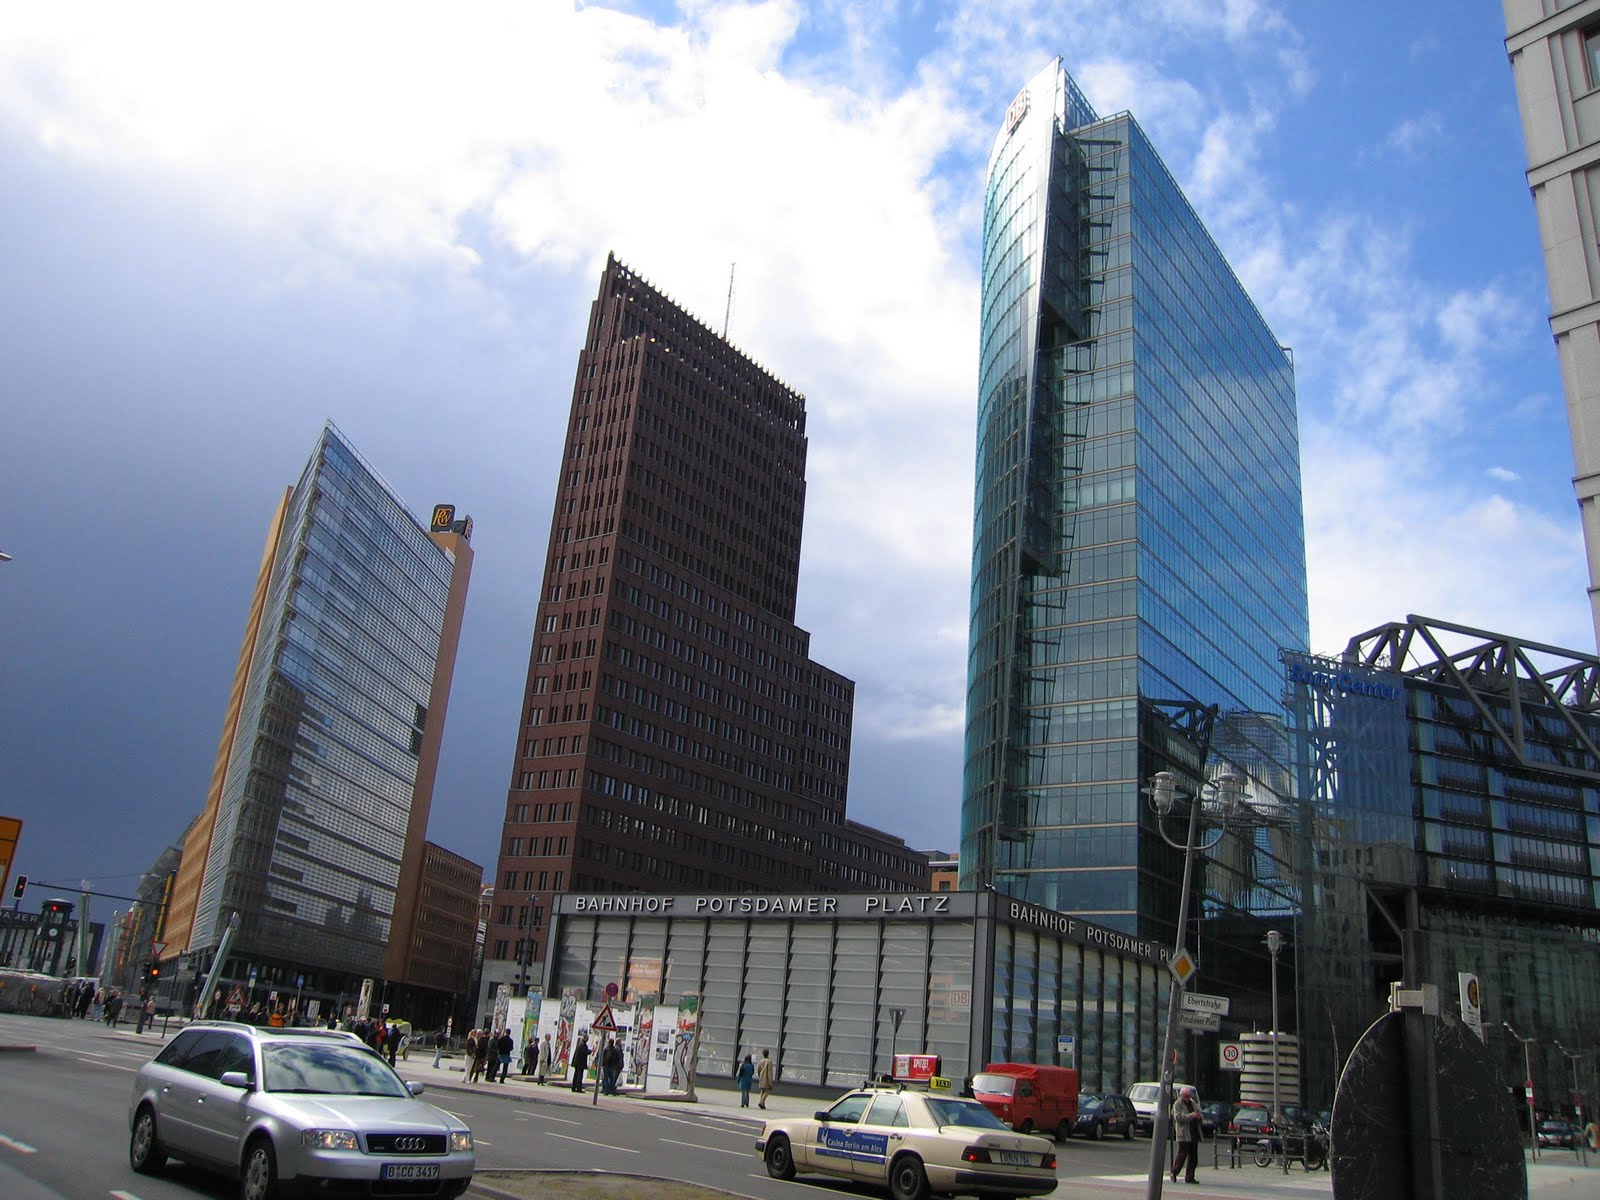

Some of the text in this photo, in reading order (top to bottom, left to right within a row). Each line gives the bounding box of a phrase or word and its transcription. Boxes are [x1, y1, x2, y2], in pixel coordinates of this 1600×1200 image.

[1291, 664, 1400, 700] Sony Center
[576, 896, 949, 912] BAHNHOF POTSDAMER PLATZ
[1010, 902, 1076, 935] BAHNHOF
[1087, 926, 1151, 957] POTSDAMER
[953, 992, 968, 1004] DB
[1227, 1050, 1236, 1058] 30
[937, 1080, 951, 1088] TAXI
[828, 1138, 844, 1149] Casino
[845, 1141, 860, 1151] Berlin
[871, 1144, 882, 1153] Alex
[416, 1166, 438, 1178] 3417
